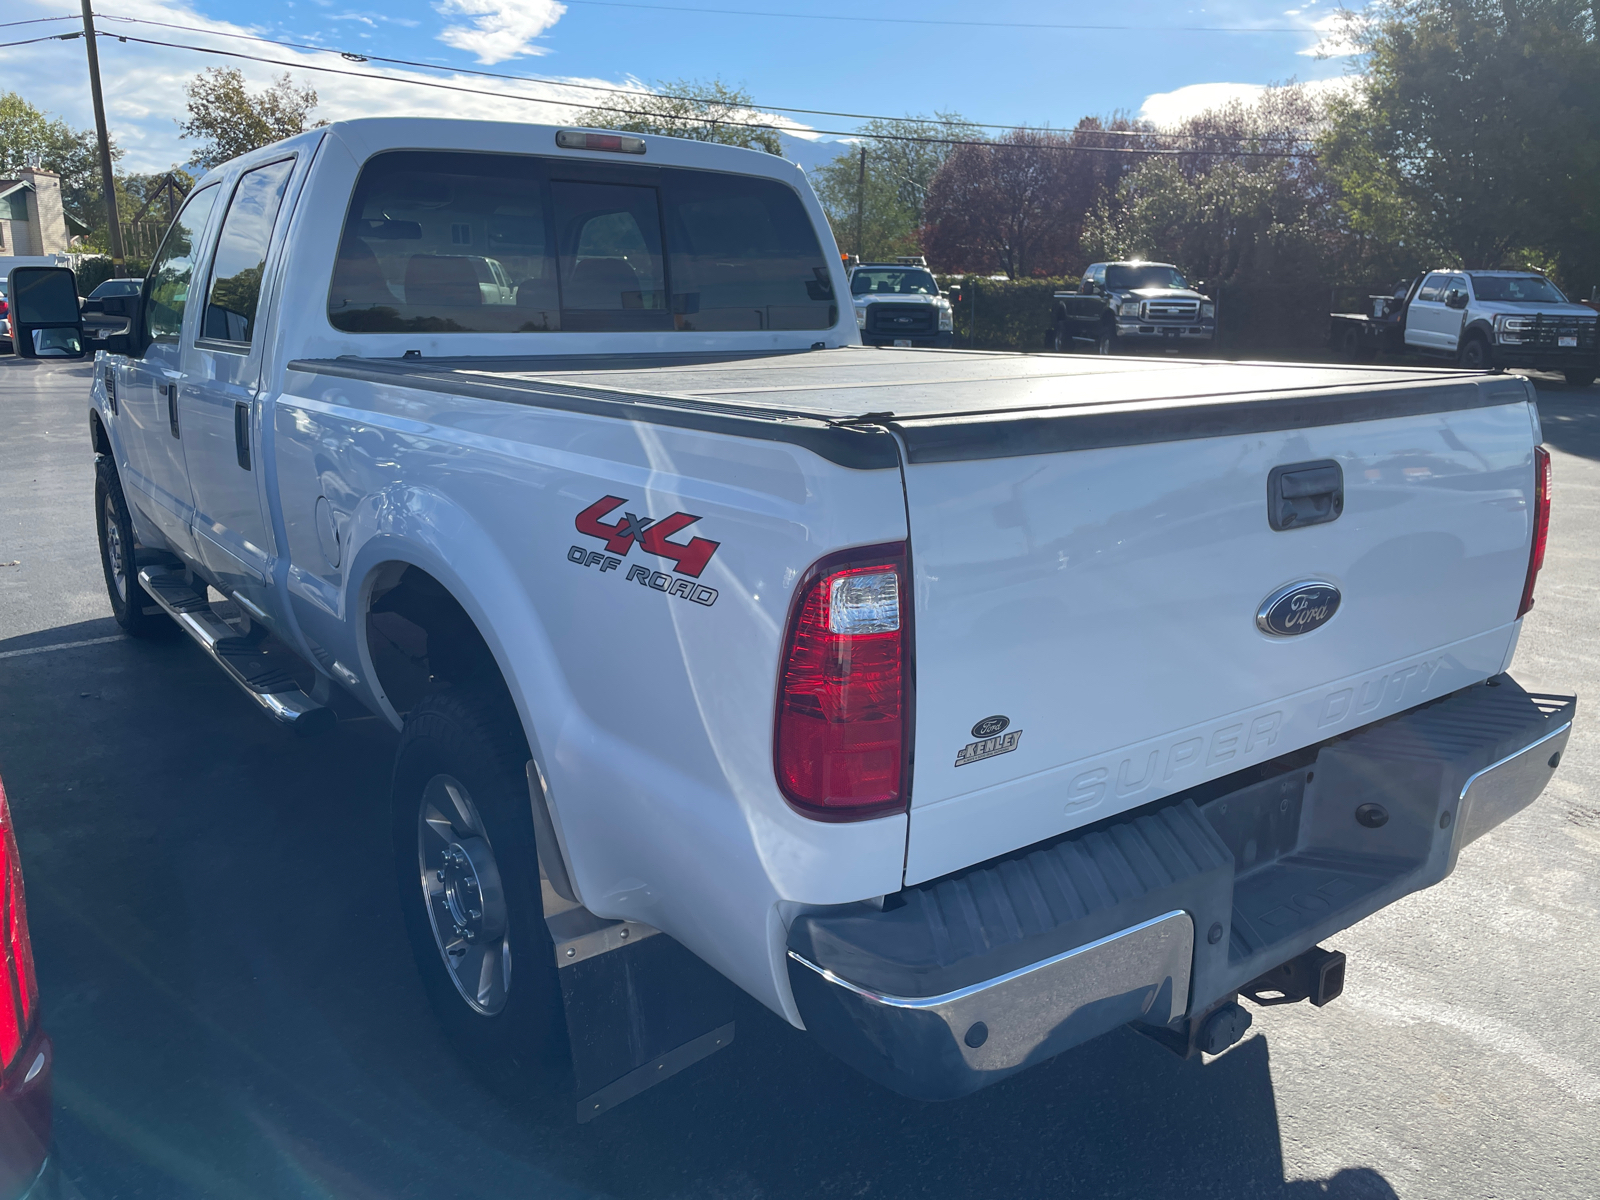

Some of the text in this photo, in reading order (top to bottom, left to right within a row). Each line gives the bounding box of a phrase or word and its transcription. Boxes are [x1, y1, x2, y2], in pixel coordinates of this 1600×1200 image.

[567, 545, 719, 607] OFF ROAD
[1284, 591, 1331, 629] Ford
[966, 731, 1021, 758] KENLEY
[1064, 655, 1445, 817] SUPER DUTY
